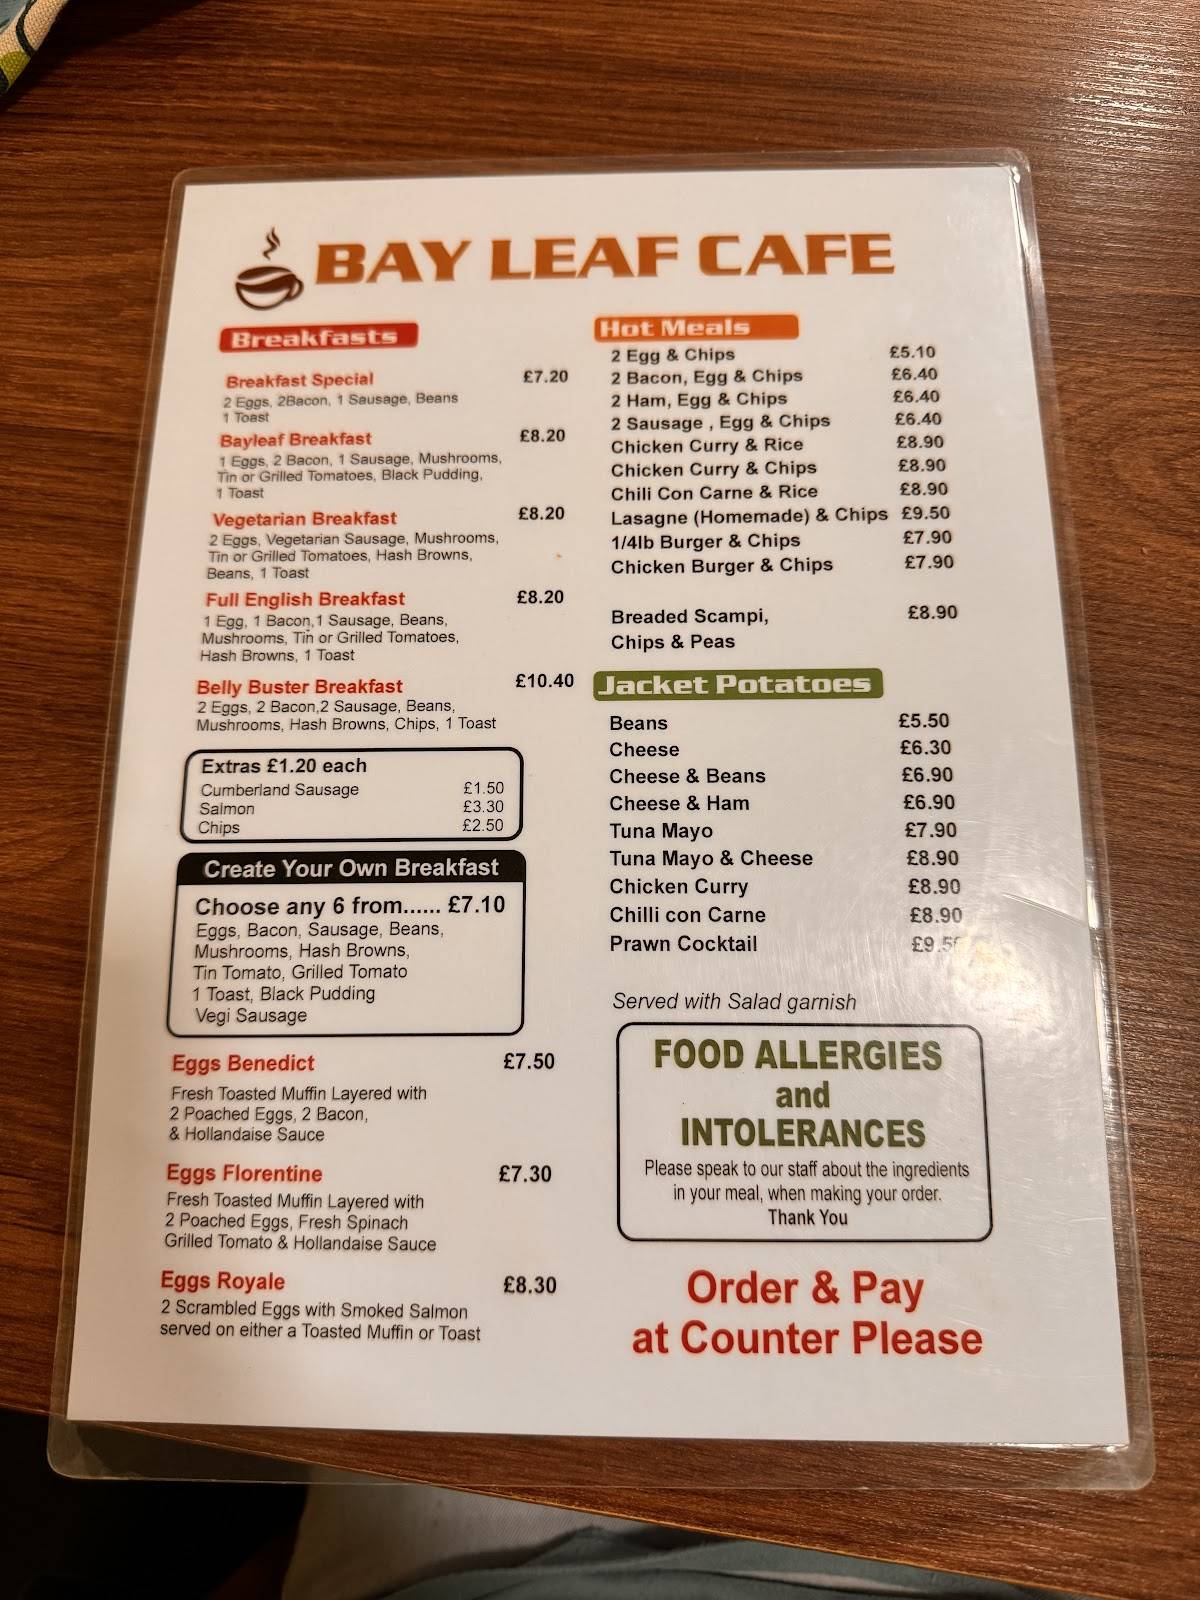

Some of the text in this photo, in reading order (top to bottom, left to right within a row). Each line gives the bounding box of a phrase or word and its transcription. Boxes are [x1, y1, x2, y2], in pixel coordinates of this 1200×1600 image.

[316, 233, 895, 284] BAY LEAF CAFE
[601, 319, 750, 337] Hot Meals
[232, 330, 398, 348] Breakfasts
[612, 348, 735, 365] 2 Egg & Chips
[890, 346, 935, 358] £5.10
[226, 372, 373, 389] Breakfast Special
[524, 370, 568, 383] £7.20
[224, 392, 458, 410] 2 Eggs, 2Bacon, 1 Sausage, Beans
[612, 392, 787, 409] 2 Ham, Egg & Chips
[894, 390, 940, 403] £6.40
[220, 432, 372, 450] Bayleaf Breakfast
[520, 429, 565, 442] £8.20
[897, 435, 944, 448] £8.90
[612, 438, 803, 455] Chicken Curry & Rice
[612, 485, 818, 501] Chili Con Carne & Rice
[900, 482, 948, 496] £8.90
[214, 512, 397, 529] Vegetarian Breakfast
[519, 506, 564, 520] £8.20
[612, 507, 888, 528] Lasagne (Homemade) & Chips
[902, 506, 950, 520] £9.50
[208, 549, 472, 562] Tin or Grilled Tomatoes, Hash Browns,
[905, 555, 954, 569] £7.90
[612, 557, 833, 576] Chicken Burger & Chips
[206, 592, 405, 610] Full English Breakfast
[517, 590, 564, 604] £8.20
[612, 608, 768, 626] Breaded Scampi,
[908, 605, 957, 619] £8.90
[612, 634, 735, 653] Chips & Peas
[197, 679, 403, 698] Belly Buster Breakfast
[516, 674, 574, 688] £10.40
[598, 675, 871, 695] Jacket Potatoes
[610, 716, 667, 730] Beans
[899, 713, 949, 728] £5.50
[610, 742, 679, 757] Cheese
[900, 740, 951, 755] £6.30
[202, 758, 366, 773] Extras £1.20 each
[610, 768, 766, 783] Cheese & Beans
[902, 767, 952, 782] £6.90
[202, 783, 358, 799] Cumberland Sausage
[464, 782, 504, 794] £1.50
[200, 802, 254, 815] Salmon
[464, 800, 503, 813] £3.30
[198, 821, 240, 837] Chips
[463, 819, 503, 831] £2.50
[610, 850, 813, 870] Tuna Mayo & Cheese
[907, 850, 958, 865] £8.90
[205, 858, 499, 878] Create Your Own Breakfast
[610, 878, 748, 898] Chicken Curry
[908, 878, 960, 894] £8.90
[196, 898, 279, 915] Choose
[287, 902, 326, 919] any
[334, 897, 344, 914] 6
[448, 896, 504, 913] £7.10
[610, 907, 765, 922] Chilli con Carne
[910, 907, 962, 923] £8.90
[611, 935, 756, 951] Prawn Cocktail
[194, 964, 407, 981] Tin Tomato, Grilled Tomato
[613, 992, 856, 1014] Served with Salad garnish
[504, 1053, 554, 1069] £7.50
[655, 1039, 942, 1070] FOOD ALLERGIES
[173, 1054, 314, 1075] Eggs Benedict
[776, 1081, 830, 1108] and
[682, 1118, 925, 1148] INTOLERANCES
[168, 1164, 322, 1185] Eggs Florentine
[499, 1165, 551, 1182] £7.30
[674, 1184, 941, 1206] in your meal, when making your order.
[768, 1209, 847, 1225] Thank You
[165, 1233, 436, 1251] Grilled Tomato & Hollandaise Sauce
[162, 1271, 285, 1294] Eggs Royale
[504, 1276, 556, 1294] £8.30
[688, 1270, 924, 1313] Order & Pay
[633, 1320, 982, 1355] at Counter Please
